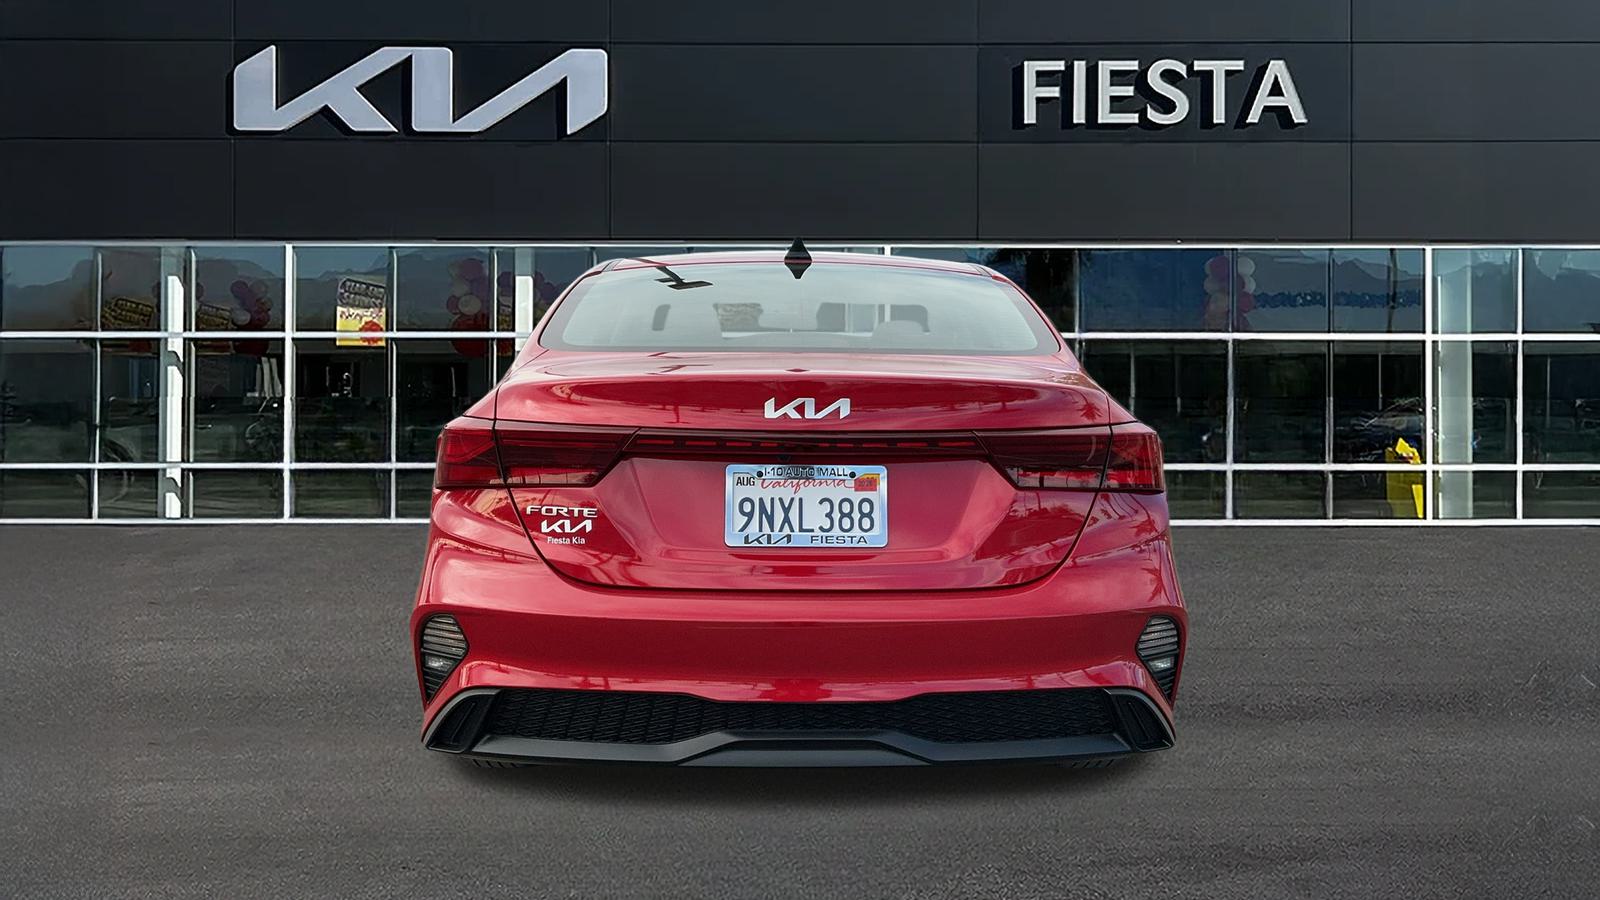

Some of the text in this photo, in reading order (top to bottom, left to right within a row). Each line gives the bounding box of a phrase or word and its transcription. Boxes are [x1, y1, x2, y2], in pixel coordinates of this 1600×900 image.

[233, 45, 608, 135] KIA
[1023, 59, 1308, 124] FIESTA
[764, 397, 850, 419] KIA
[785, 467, 815, 477] AUTO
[820, 467, 848, 477] MALL
[736, 476, 755, 486] AUG
[761, 479, 847, 494] California
[526, 505, 598, 518] FORTE
[738, 497, 875, 533] 9NXL388
[744, 533, 792, 544] KIA
[810, 535, 868, 544] FIESTA
